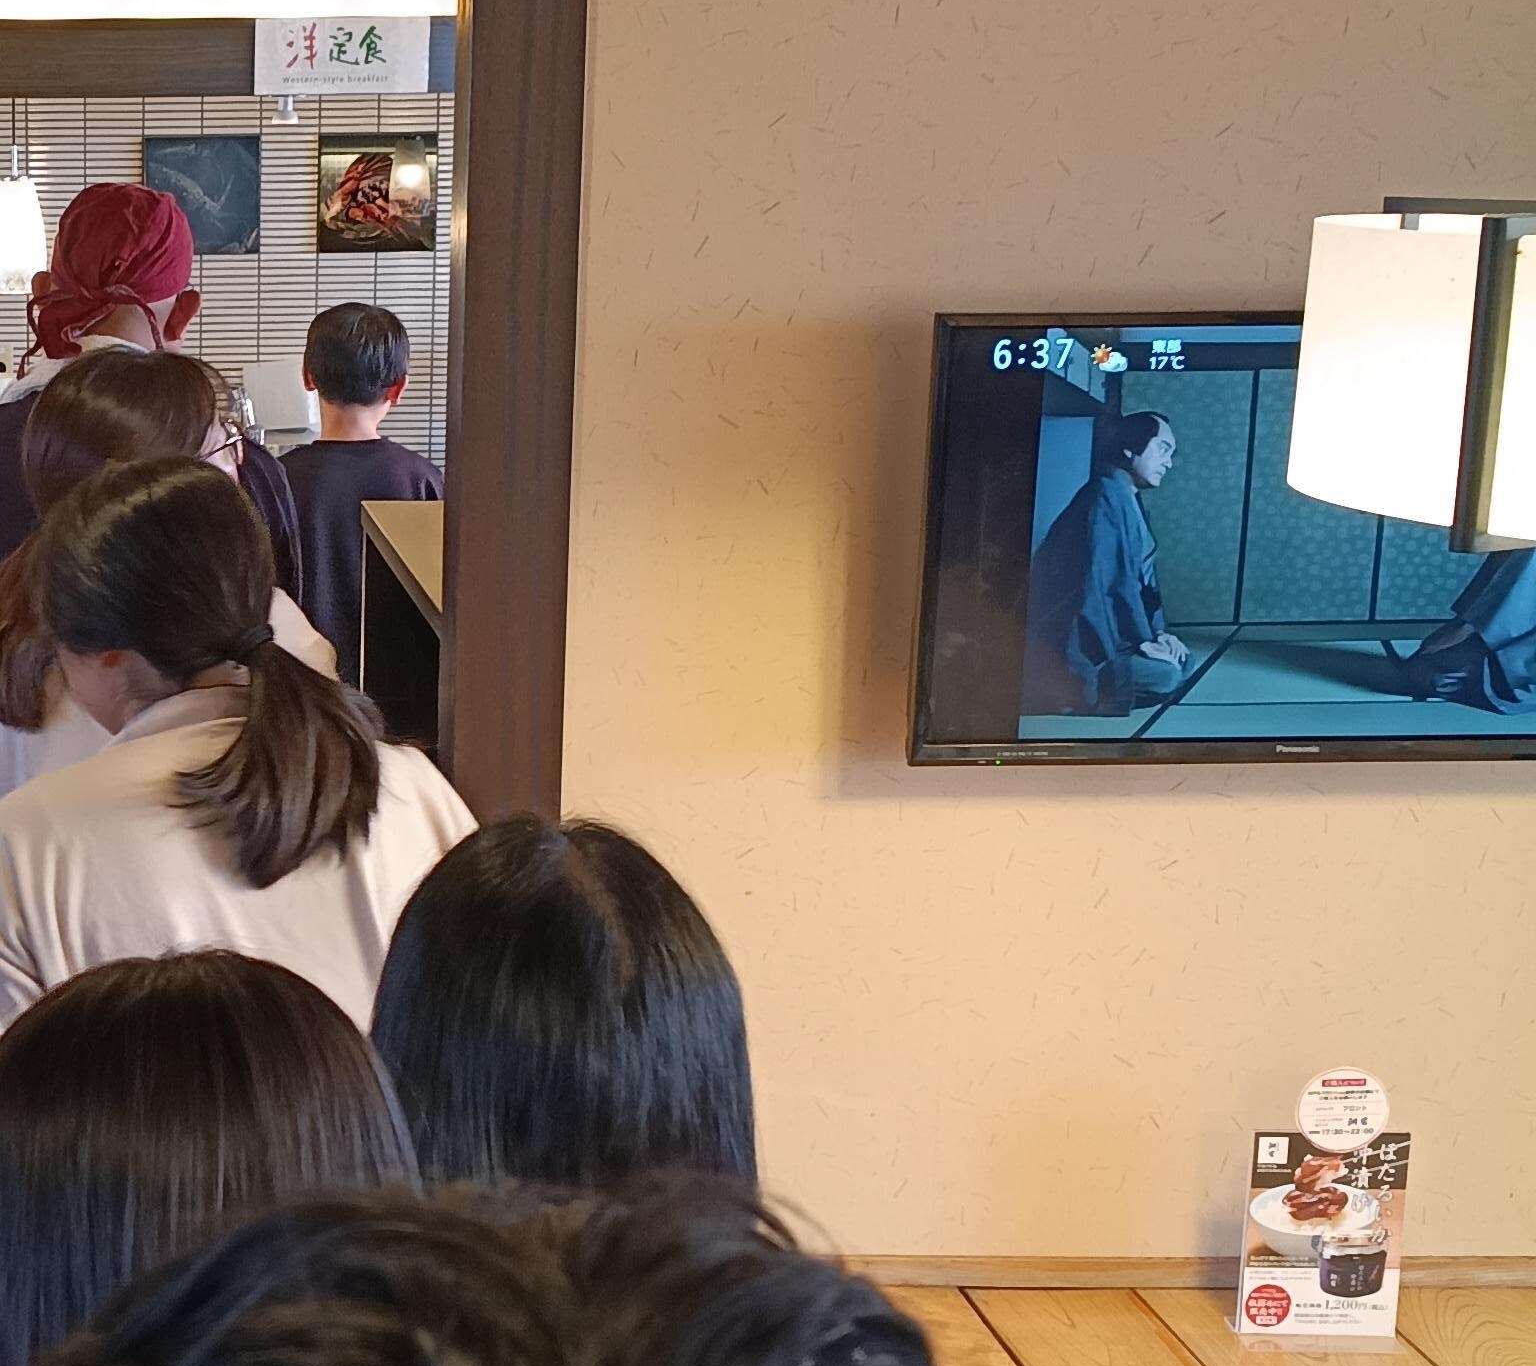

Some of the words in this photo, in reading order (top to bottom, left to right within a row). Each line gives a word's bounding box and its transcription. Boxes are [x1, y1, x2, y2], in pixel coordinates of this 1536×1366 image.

[286, 22, 386, 69] 洋定食
[348, 75, 388, 83] breakfast
[993, 338, 1074, 370] 6:37
[1152, 339, 1182, 353] 東部
